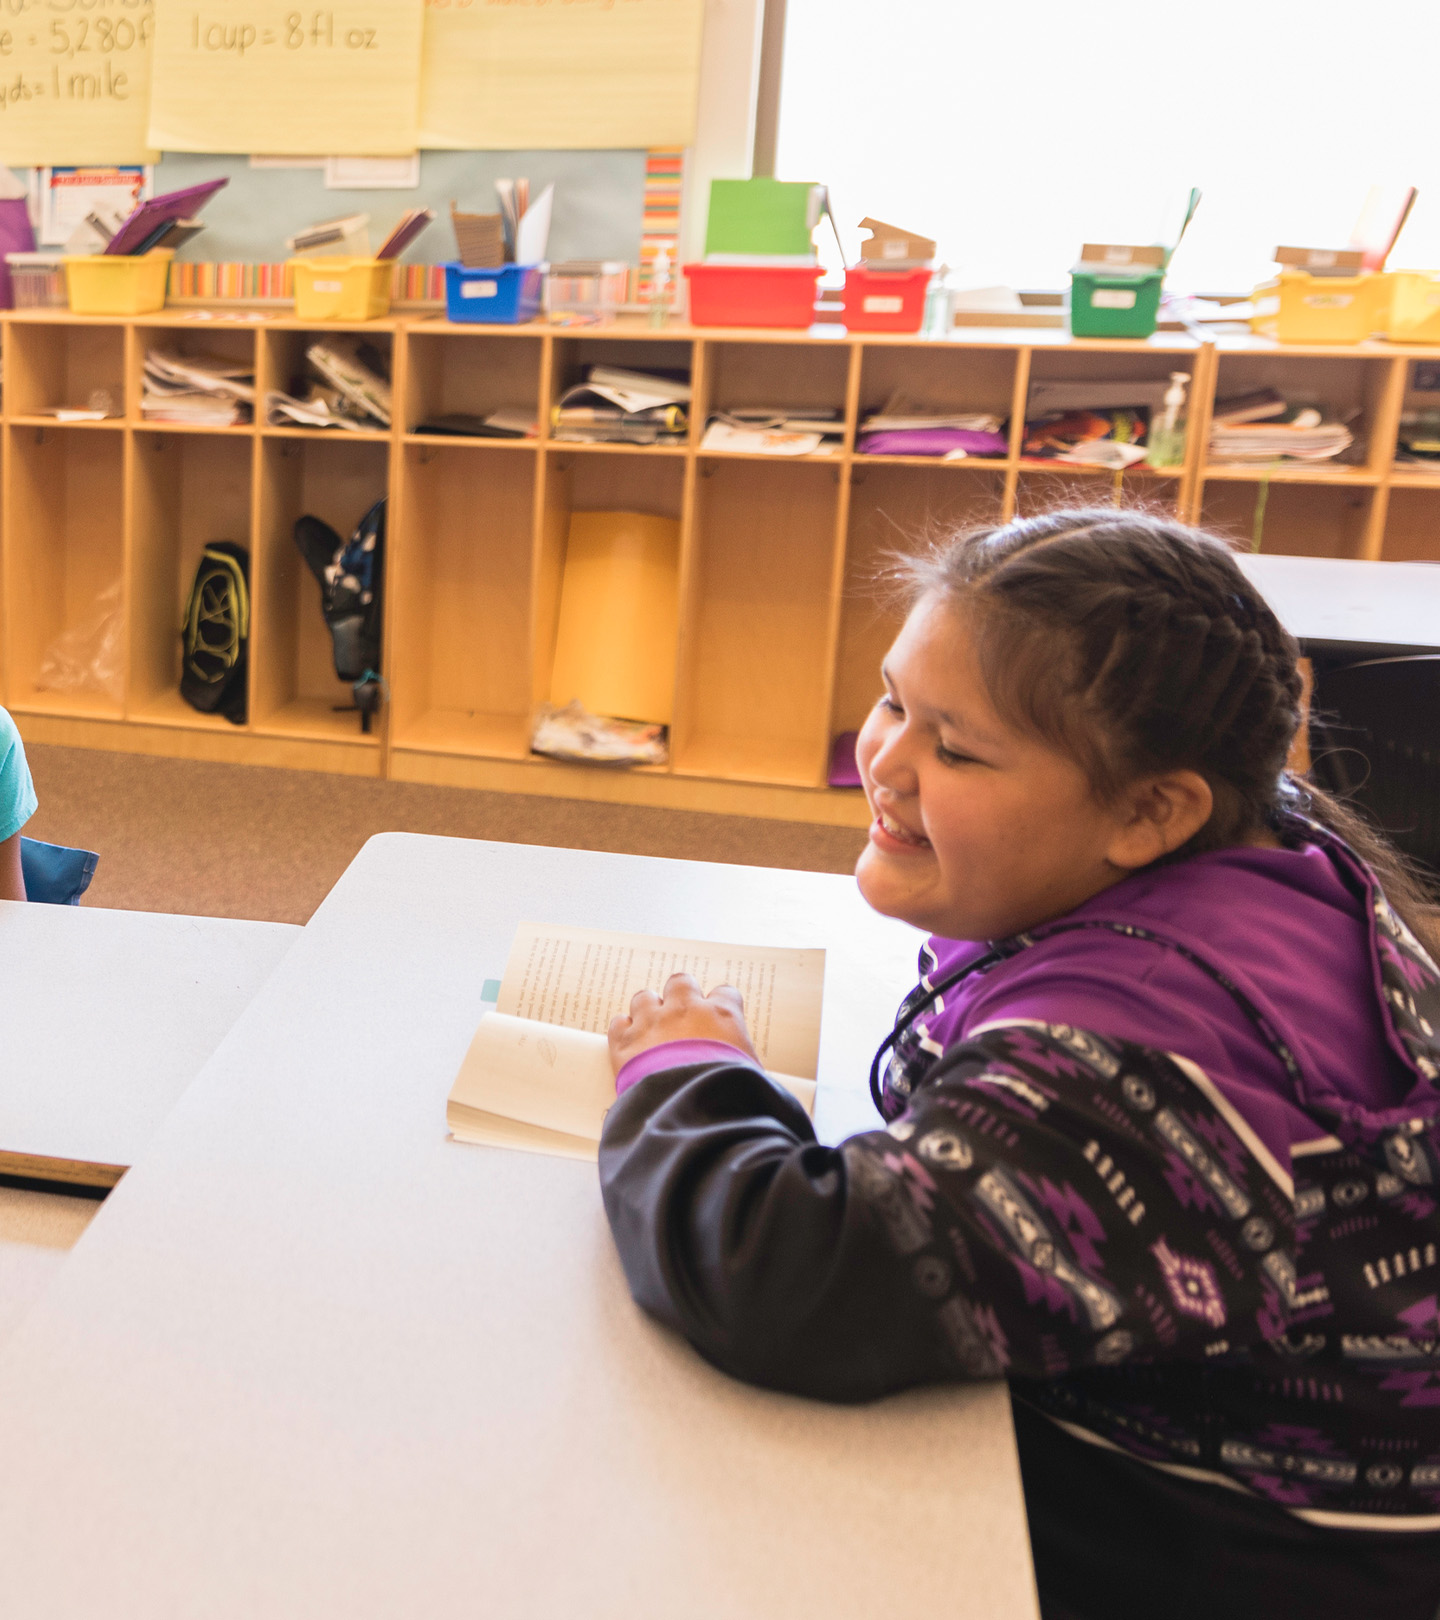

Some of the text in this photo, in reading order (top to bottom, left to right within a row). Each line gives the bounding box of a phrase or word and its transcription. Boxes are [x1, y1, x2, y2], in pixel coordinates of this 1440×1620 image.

[203, 22, 257, 57] cup
[283, 10, 306, 50] 8
[344, 26, 380, 51] oz
[67, 59, 130, 101] mile
